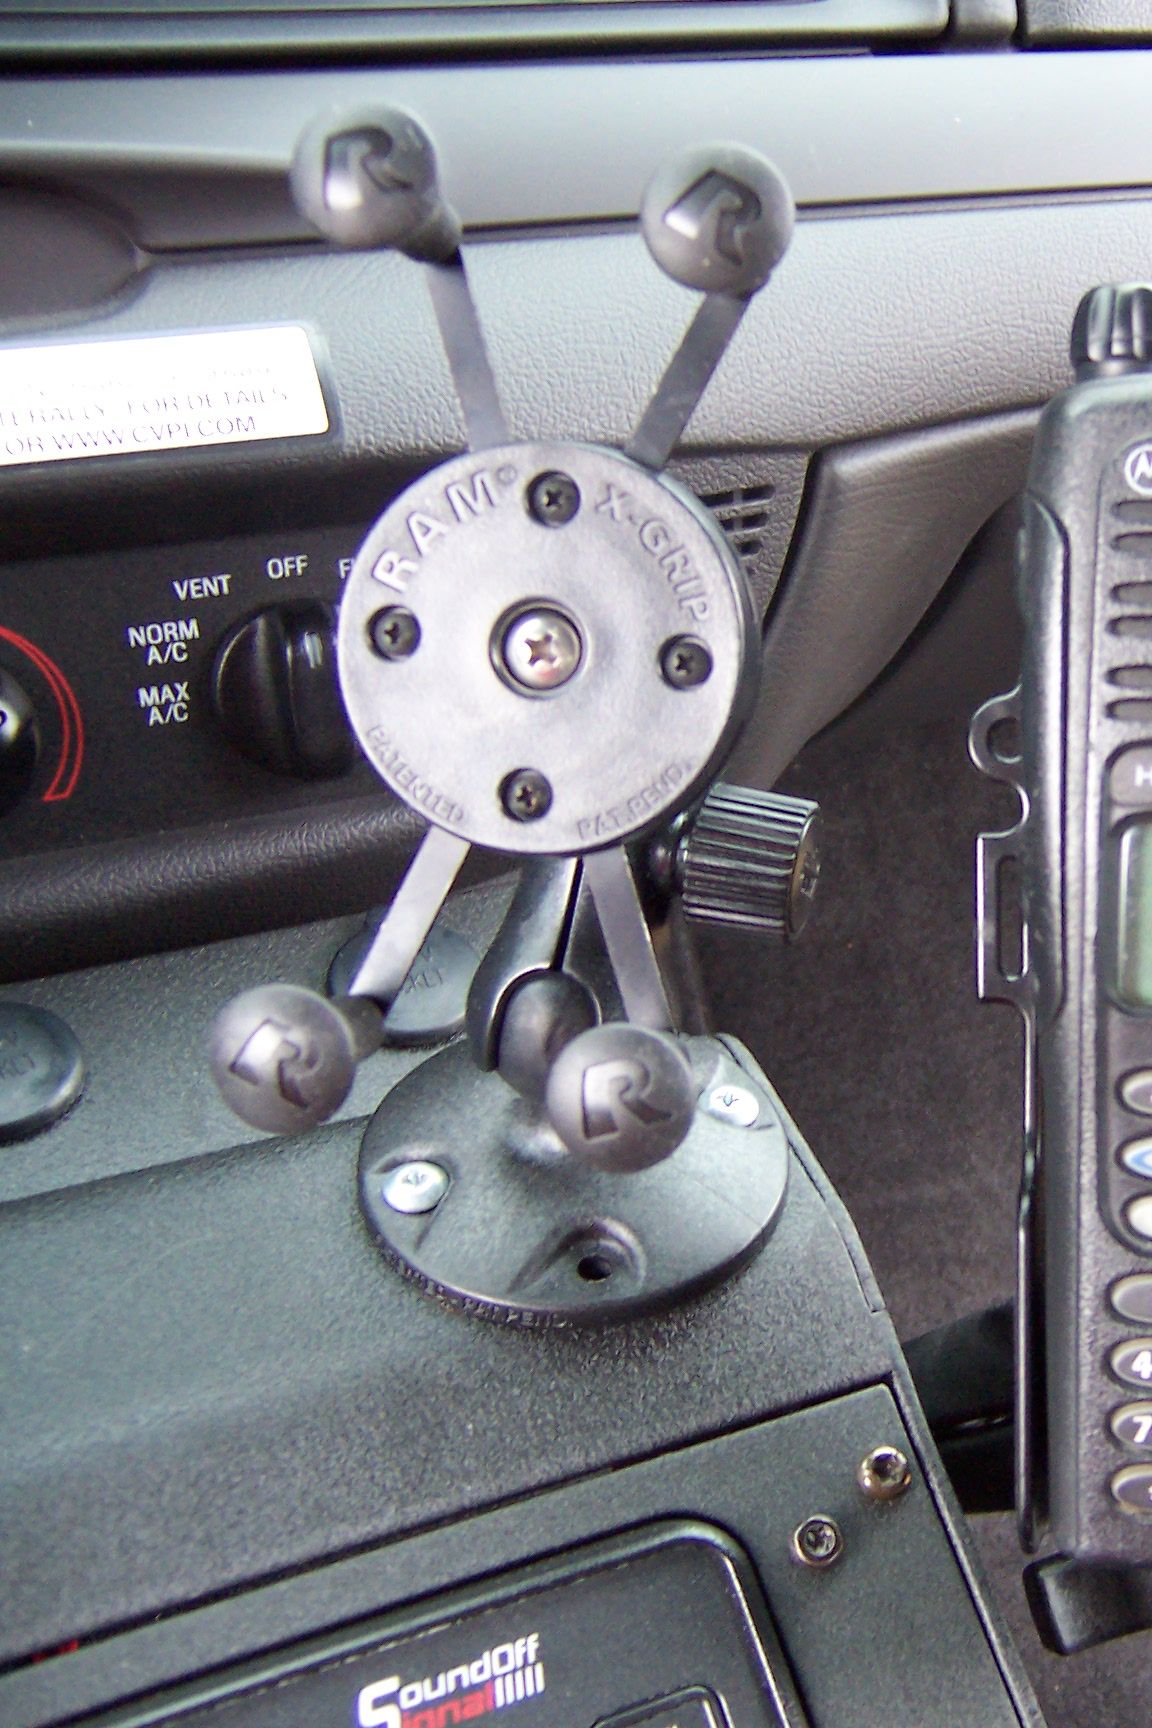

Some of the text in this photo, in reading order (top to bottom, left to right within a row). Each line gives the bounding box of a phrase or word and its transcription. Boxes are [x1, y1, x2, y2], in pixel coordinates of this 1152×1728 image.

[595, 483, 710, 621] X-GRIP
[266, 555, 309, 580] OFF
[172, 574, 232, 602] VENT
[128, 617, 200, 648] NORM
[146, 642, 189, 667] A/C
[137, 682, 191, 708] MAX
[148, 702, 189, 727] A/C
